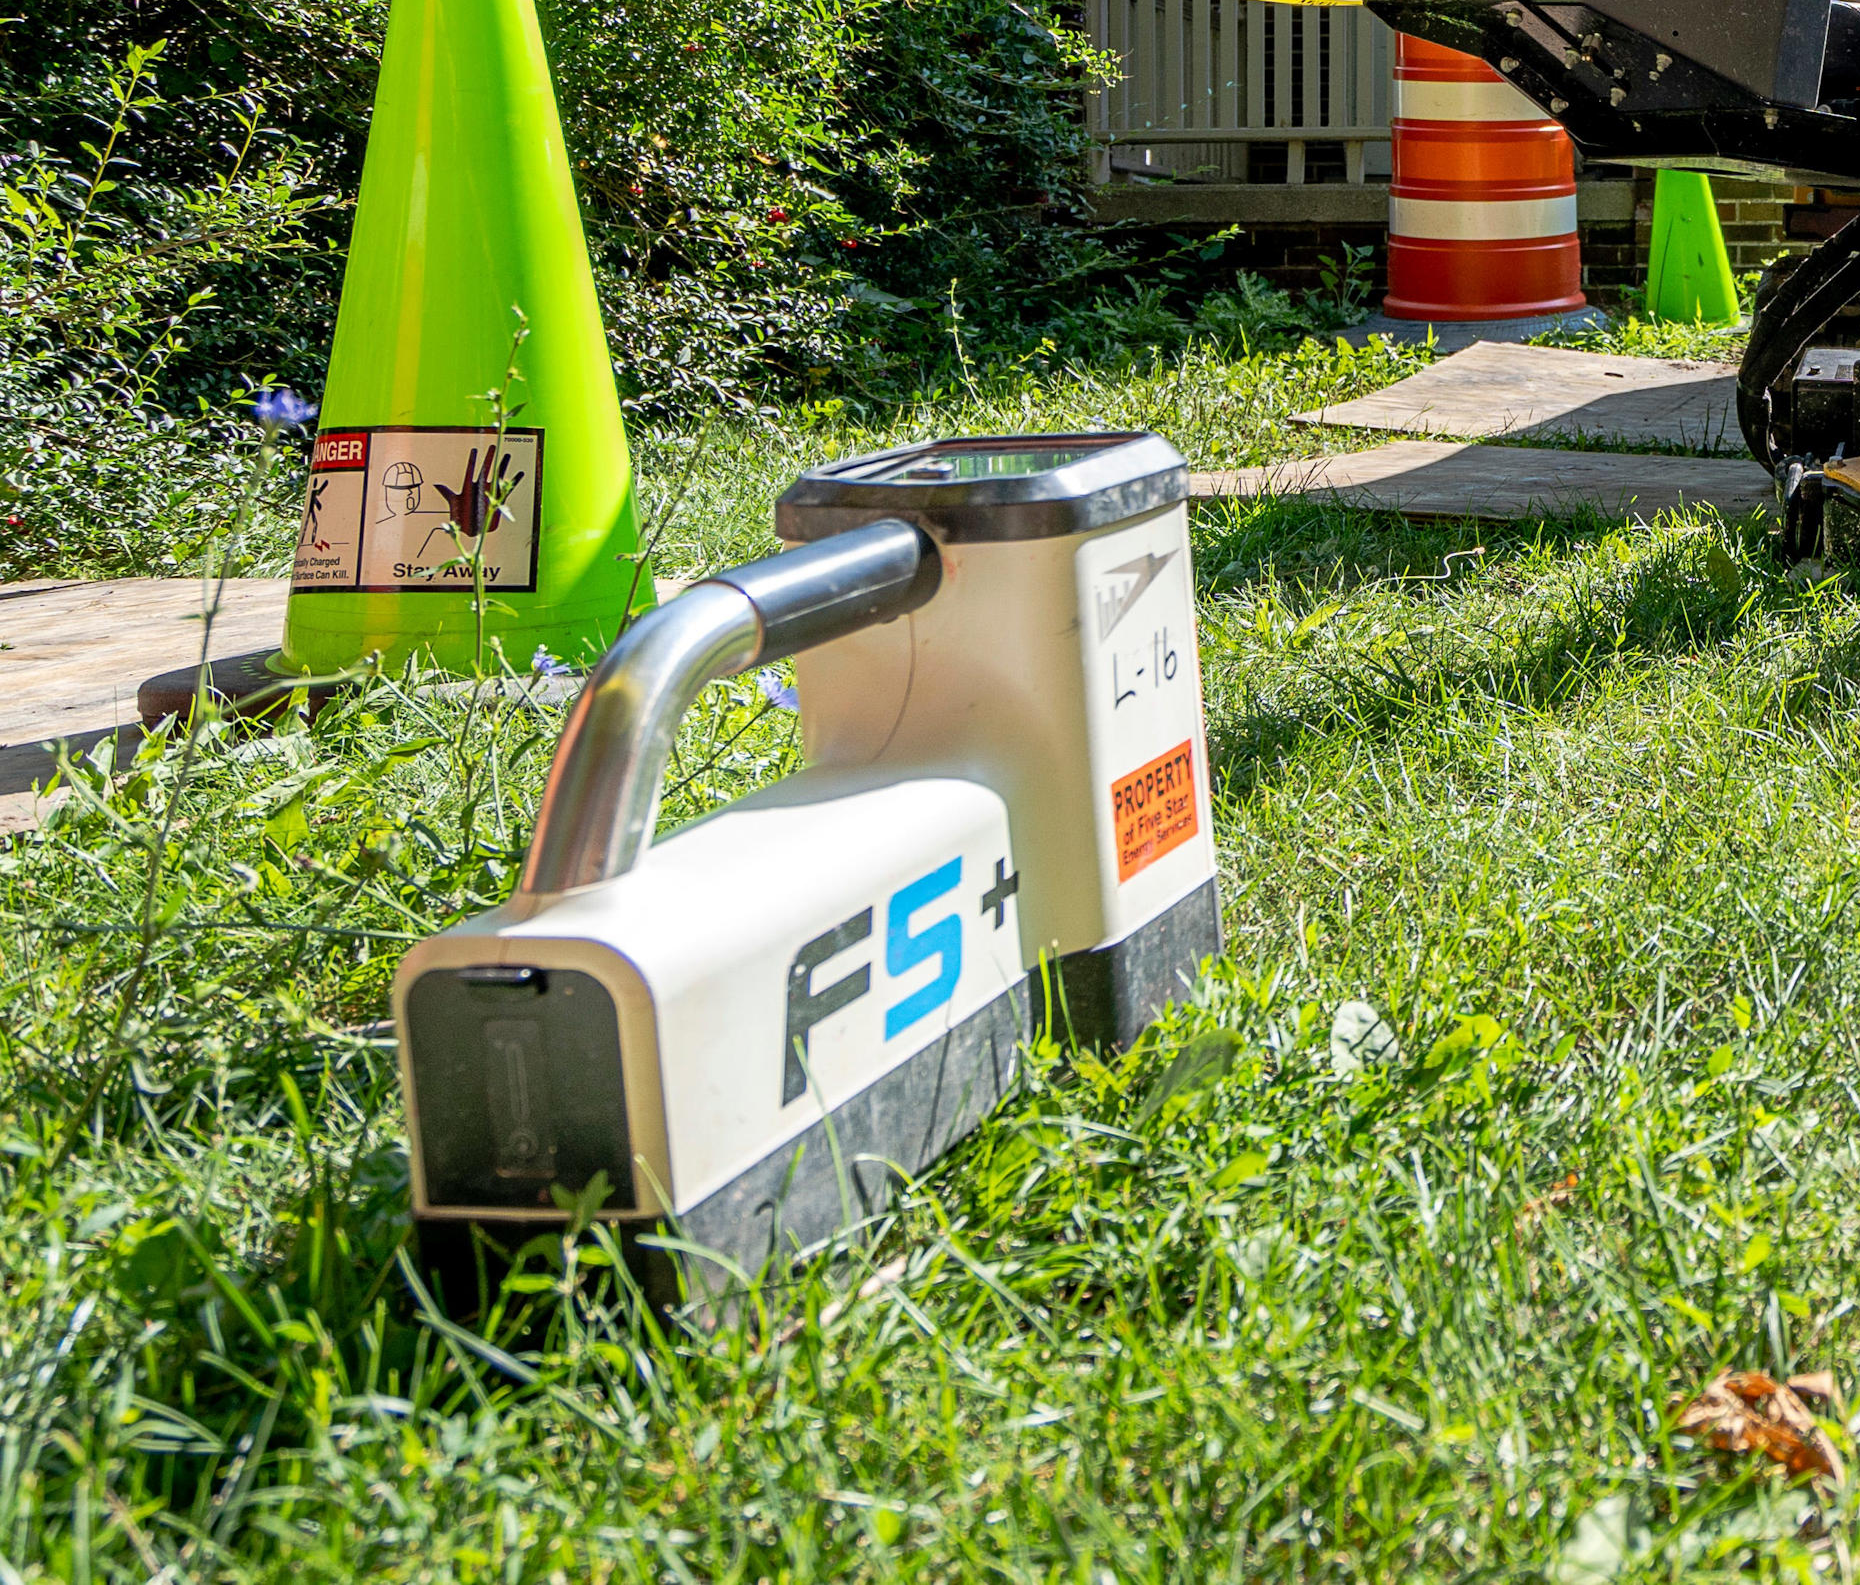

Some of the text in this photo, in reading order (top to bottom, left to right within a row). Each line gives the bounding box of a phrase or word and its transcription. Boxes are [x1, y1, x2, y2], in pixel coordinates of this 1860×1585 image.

[310, 556, 341, 568] Charged
[315, 570, 330, 580] Can
[332, 569, 350, 580] Kill.
[1114, 748, 1193, 823] PROPERTY
[1122, 815, 1193, 866] Energy Services
[1123, 792, 1190, 846] of Five Star
